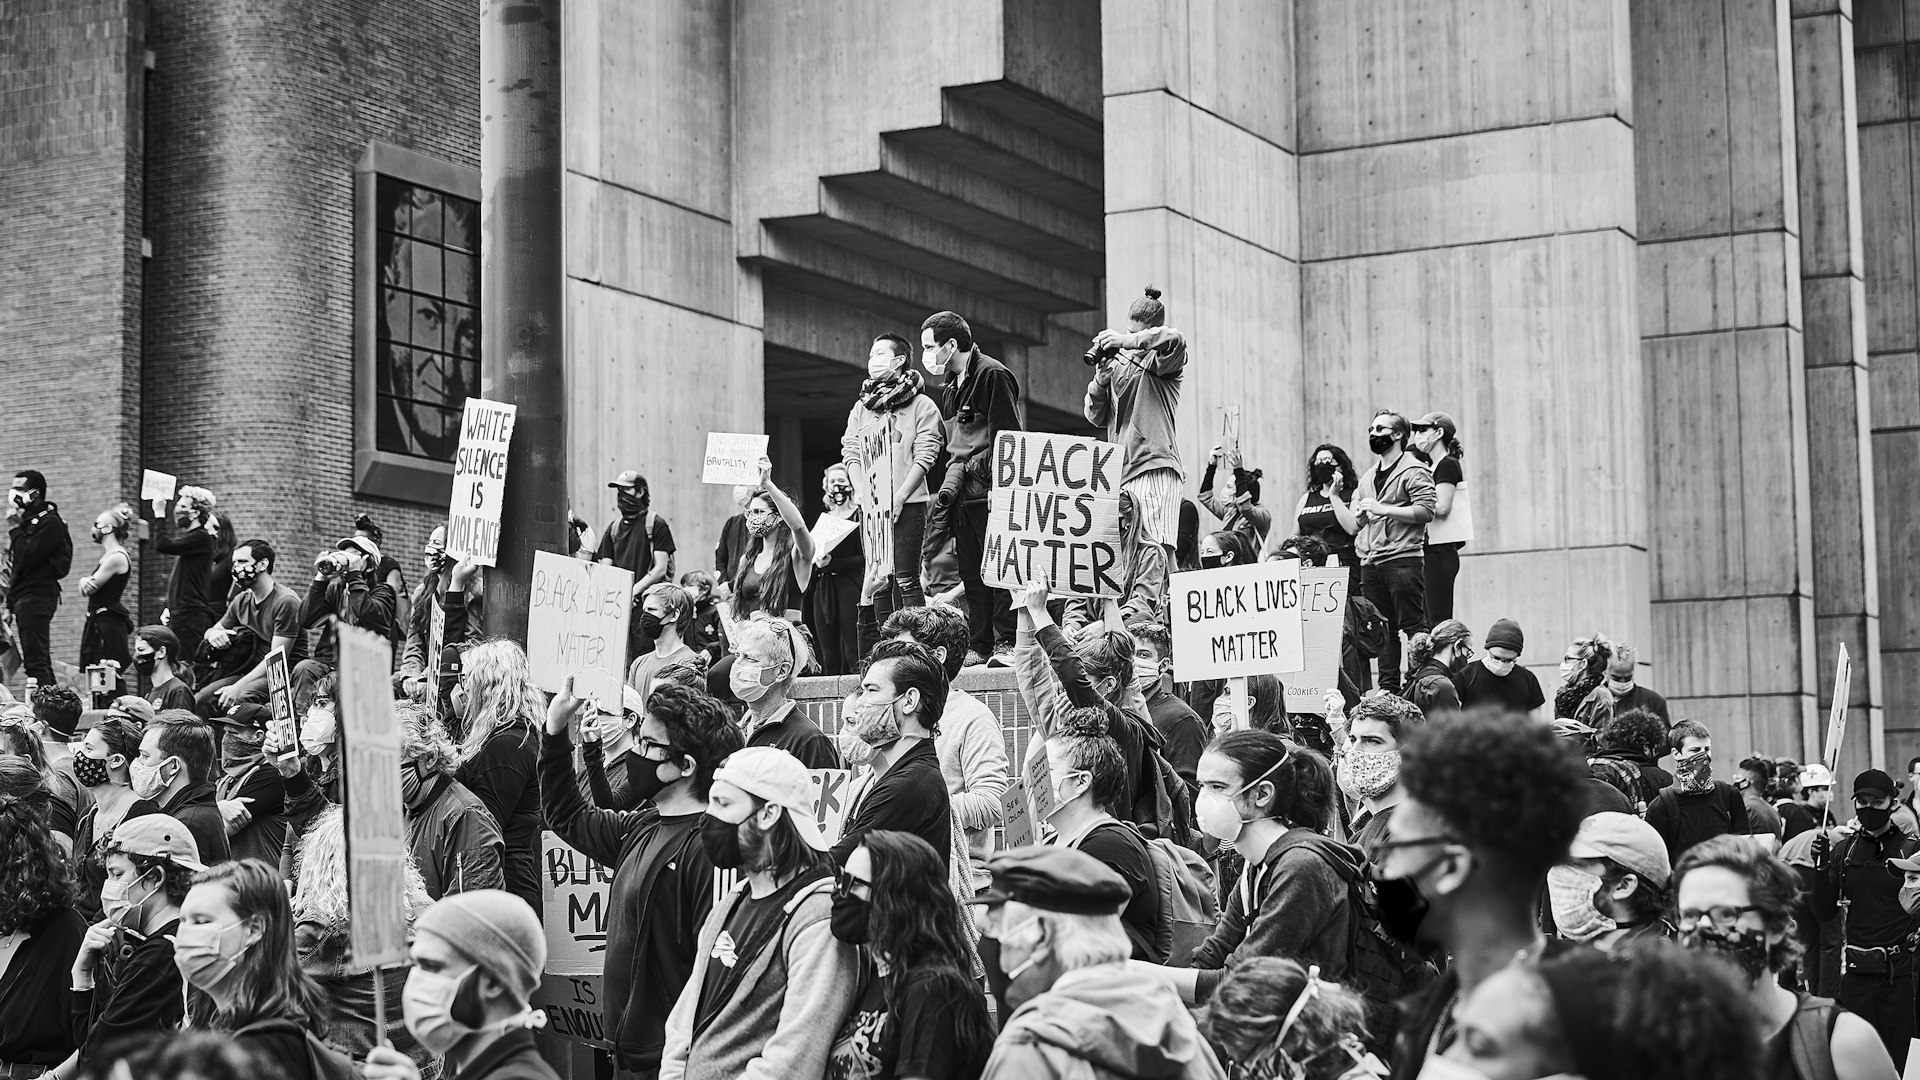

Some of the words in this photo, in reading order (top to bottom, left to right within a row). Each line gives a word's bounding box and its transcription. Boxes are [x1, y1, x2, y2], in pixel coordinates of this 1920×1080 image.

[466, 407, 511, 443] WHITE
[456, 447, 505, 480] SILENCE
[706, 456, 747, 469] BRUTALITY
[997, 433, 1115, 494] BLACK
[470, 481, 484, 509] IS
[1008, 488, 1095, 537] LIVES
[449, 513, 501, 559] VIOLENCE
[981, 533, 1123, 594] MATTER
[534, 570, 579, 613] BLACK
[586, 584, 622, 620] LIVES
[1187, 585, 1247, 623] BLACK
[1254, 579, 1298, 612] LIVES
[557, 632, 606, 668] MATTER
[1211, 629, 1279, 664] MATTER
[1287, 687, 1319, 696] COOKIES
[1006, 797, 1020, 812] SEE
[1008, 808, 1025, 824] COLOR
[568, 978, 596, 1005] IS
